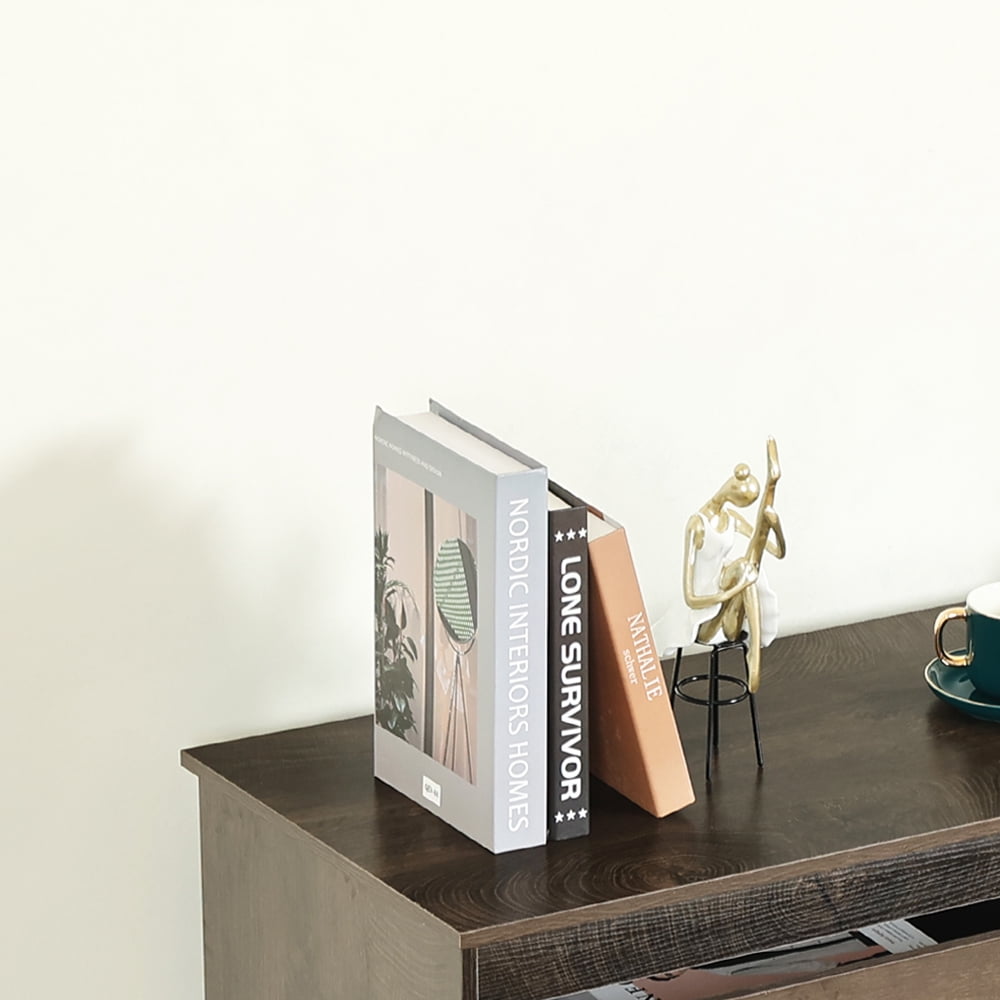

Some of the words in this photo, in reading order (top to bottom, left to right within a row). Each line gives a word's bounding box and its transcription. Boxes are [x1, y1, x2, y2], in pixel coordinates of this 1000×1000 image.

[509, 498, 528, 598] NORDIC
[561, 556, 582, 637] LONE
[509, 604, 528, 736] INTERIORS
[627, 611, 663, 701] NATHALIE
[561, 641, 582, 802] SURVIVOR
[508, 741, 528, 832] HOMES
